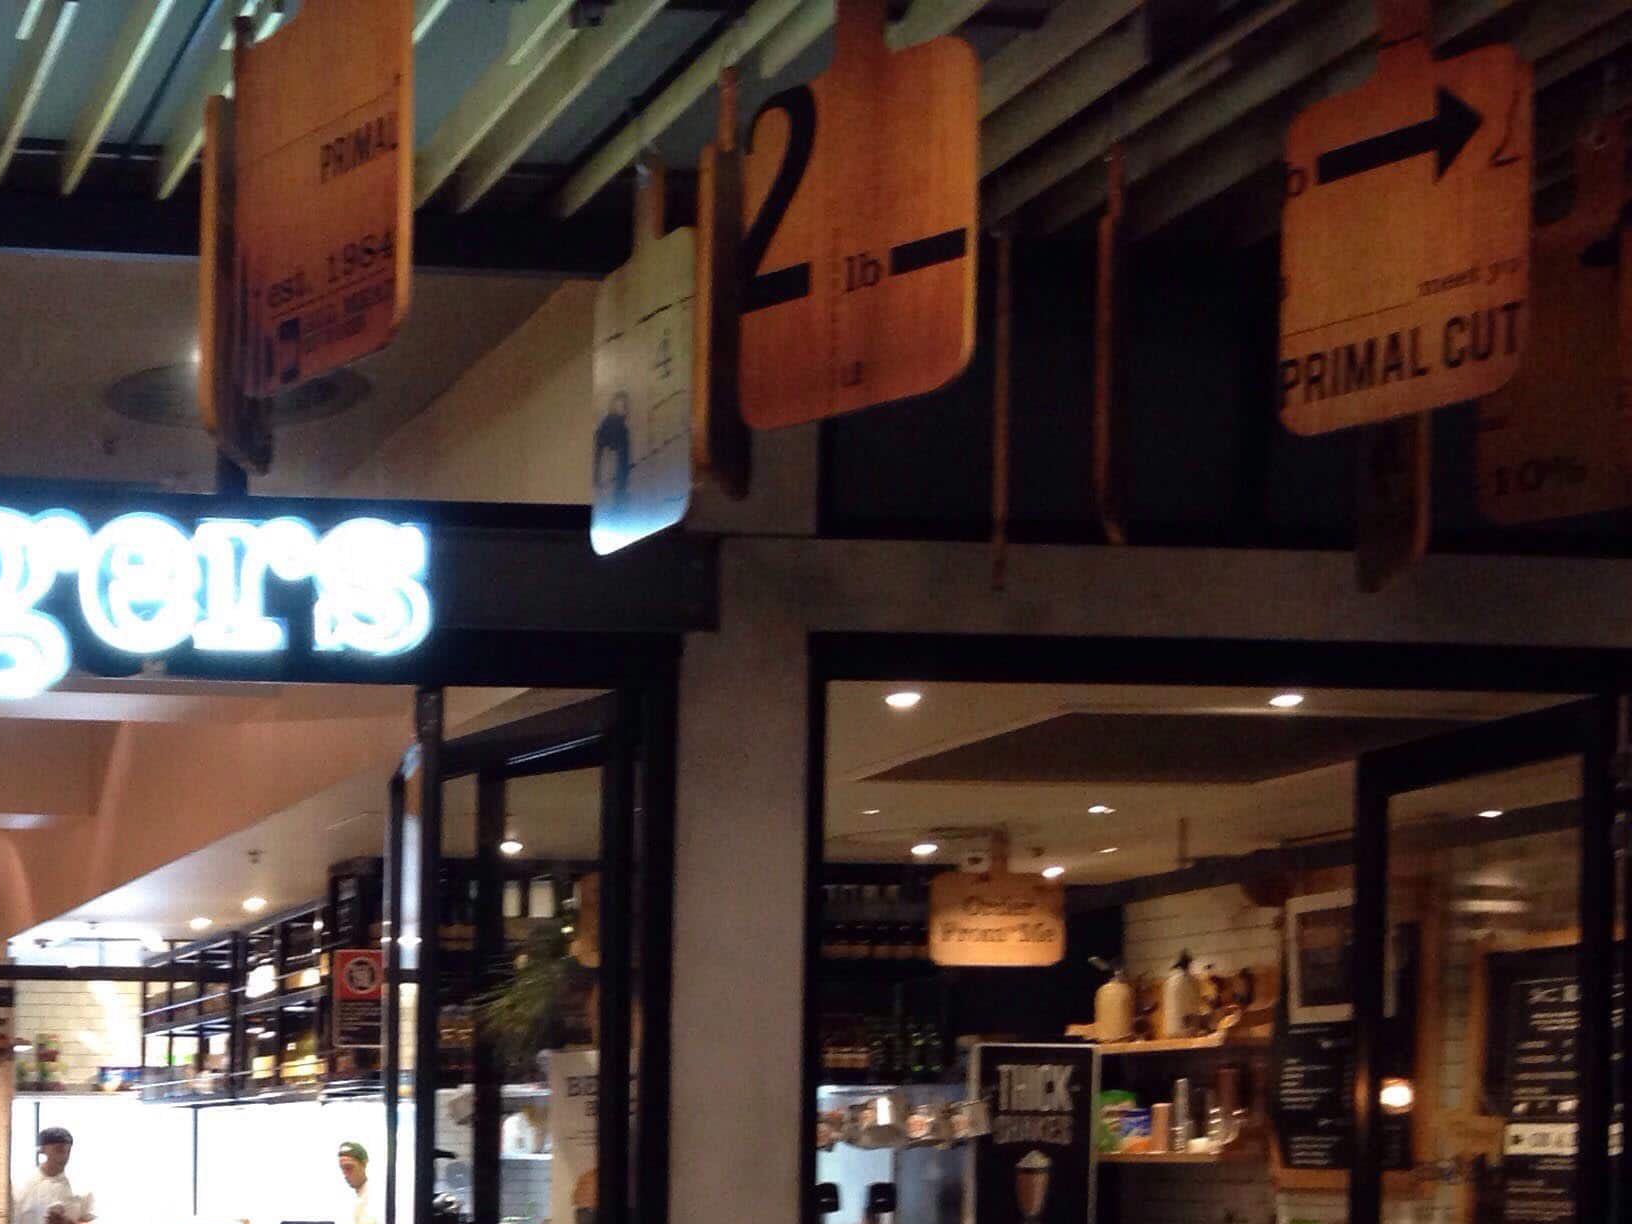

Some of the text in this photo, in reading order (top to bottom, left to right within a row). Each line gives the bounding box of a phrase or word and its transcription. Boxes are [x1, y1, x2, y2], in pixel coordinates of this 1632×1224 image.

[320, 111, 399, 184] PRIMAL
[1280, 302, 1523, 407] PRIMAL CUT
